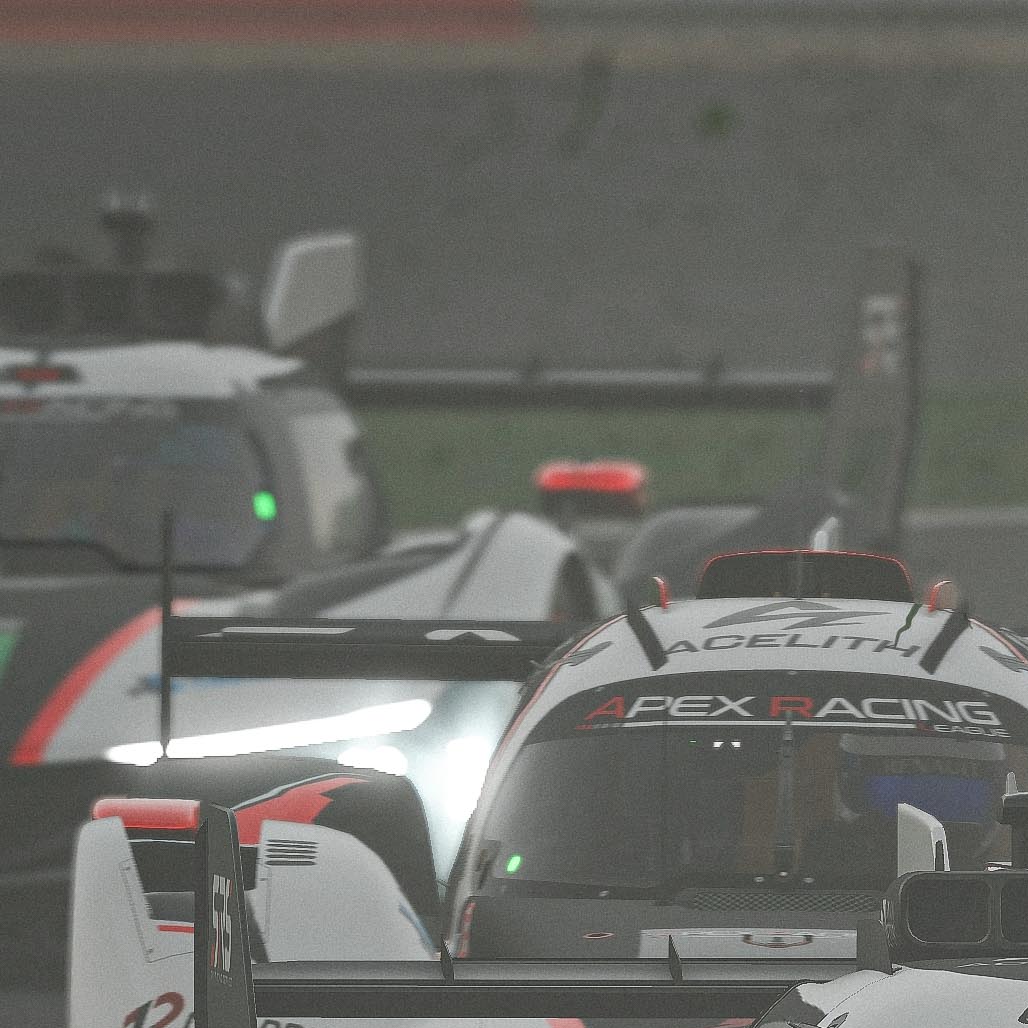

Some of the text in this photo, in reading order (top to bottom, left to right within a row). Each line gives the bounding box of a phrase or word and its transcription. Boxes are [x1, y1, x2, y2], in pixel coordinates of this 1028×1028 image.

[665, 634, 921, 658] ACELITH
[584, 695, 1002, 726] APEX RACING
[916, 723, 1012, 738] LEAGUE
